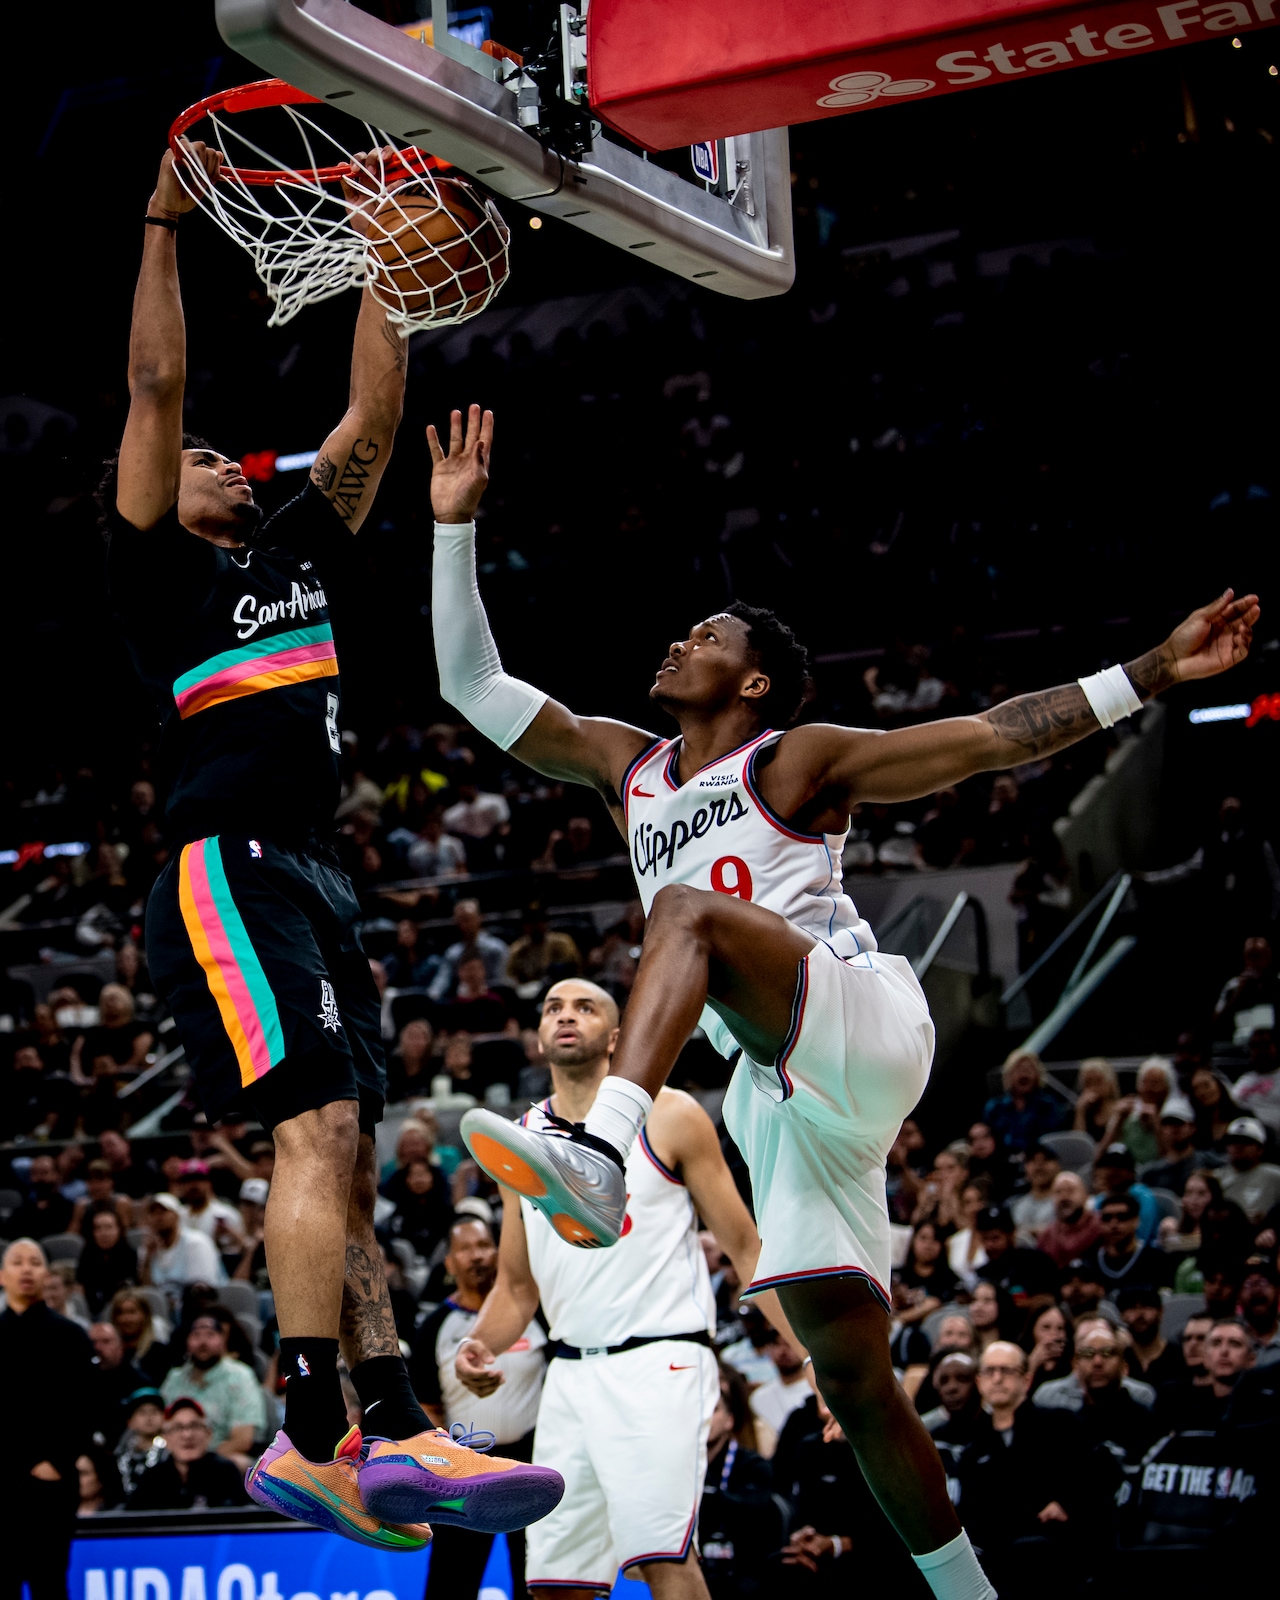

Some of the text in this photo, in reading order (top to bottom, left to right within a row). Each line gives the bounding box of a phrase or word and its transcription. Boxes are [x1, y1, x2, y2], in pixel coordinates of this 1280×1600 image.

[935, 23, 1155, 85] State
[233, 595, 285, 639] San
[699, 777, 739, 787] RWANDA
[711, 773, 734, 781] VISIT
[634, 791, 749, 877] Clippers
[710, 855, 753, 903] 9
[1142, 1462, 1179, 1493] GET
[1179, 1464, 1216, 1497] THE
